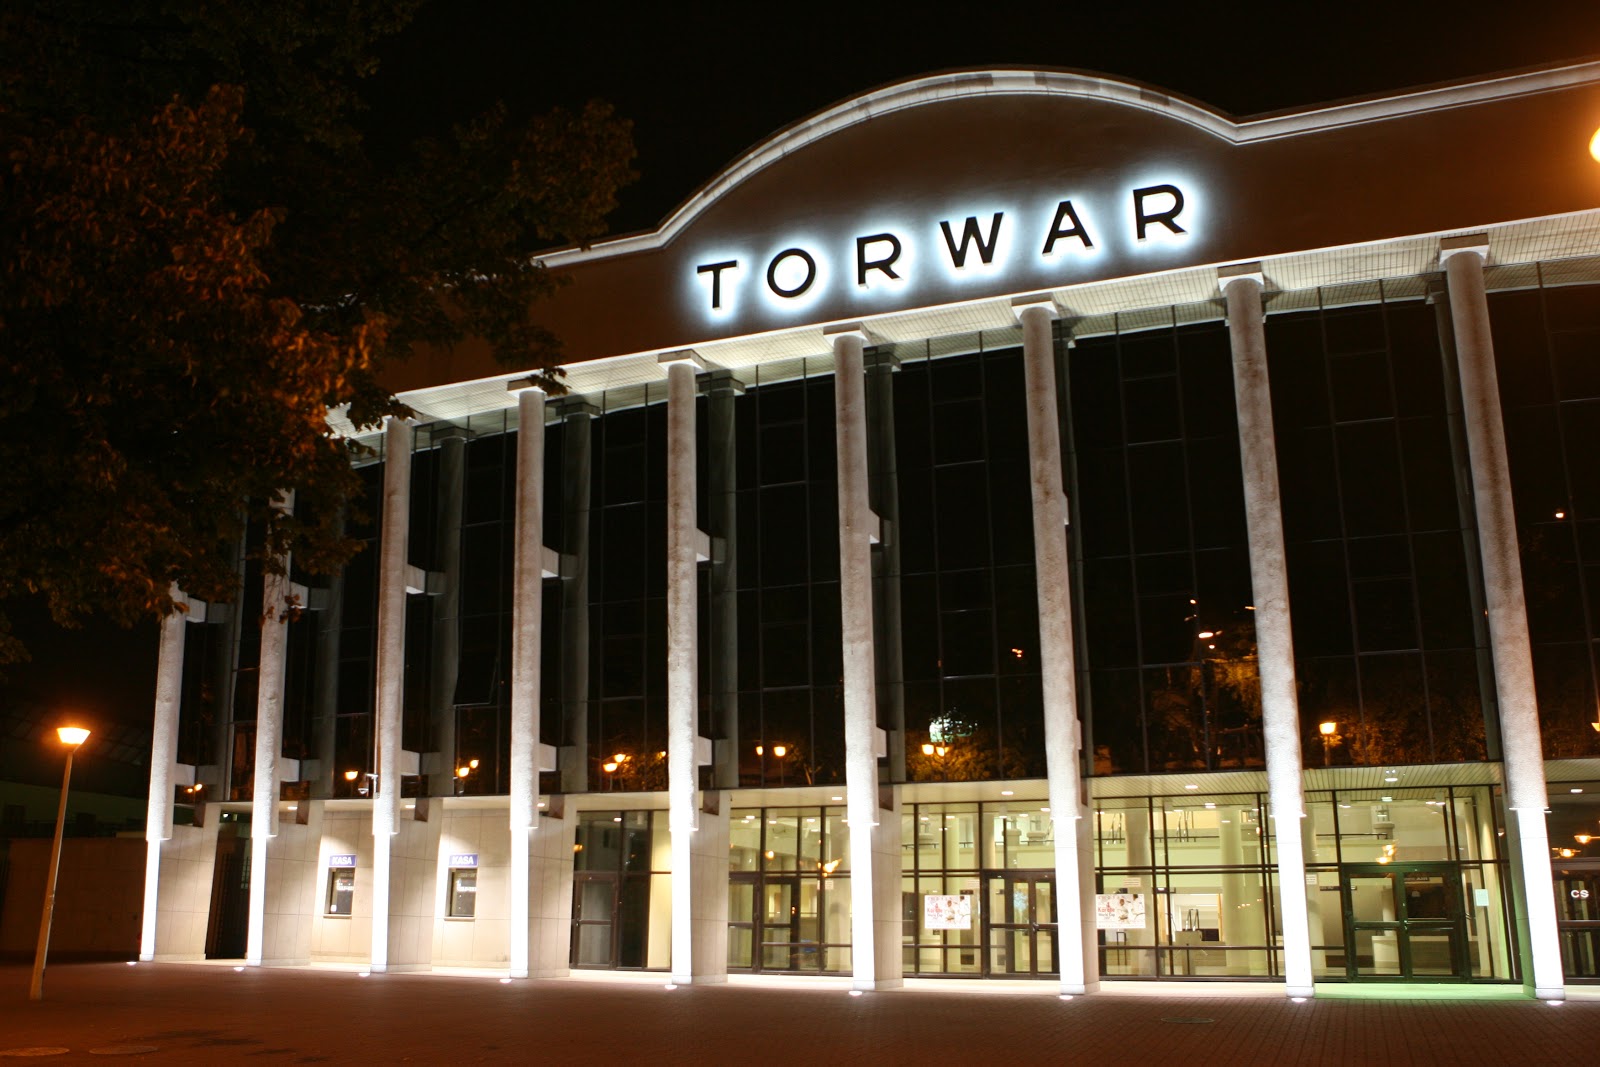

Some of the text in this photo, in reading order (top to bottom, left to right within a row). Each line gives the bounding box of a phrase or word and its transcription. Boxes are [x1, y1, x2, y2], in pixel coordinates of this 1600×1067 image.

[696, 183, 1189, 310] TORWAR
[332, 856, 352, 865] KASA
[452, 856, 474, 865] KASA
